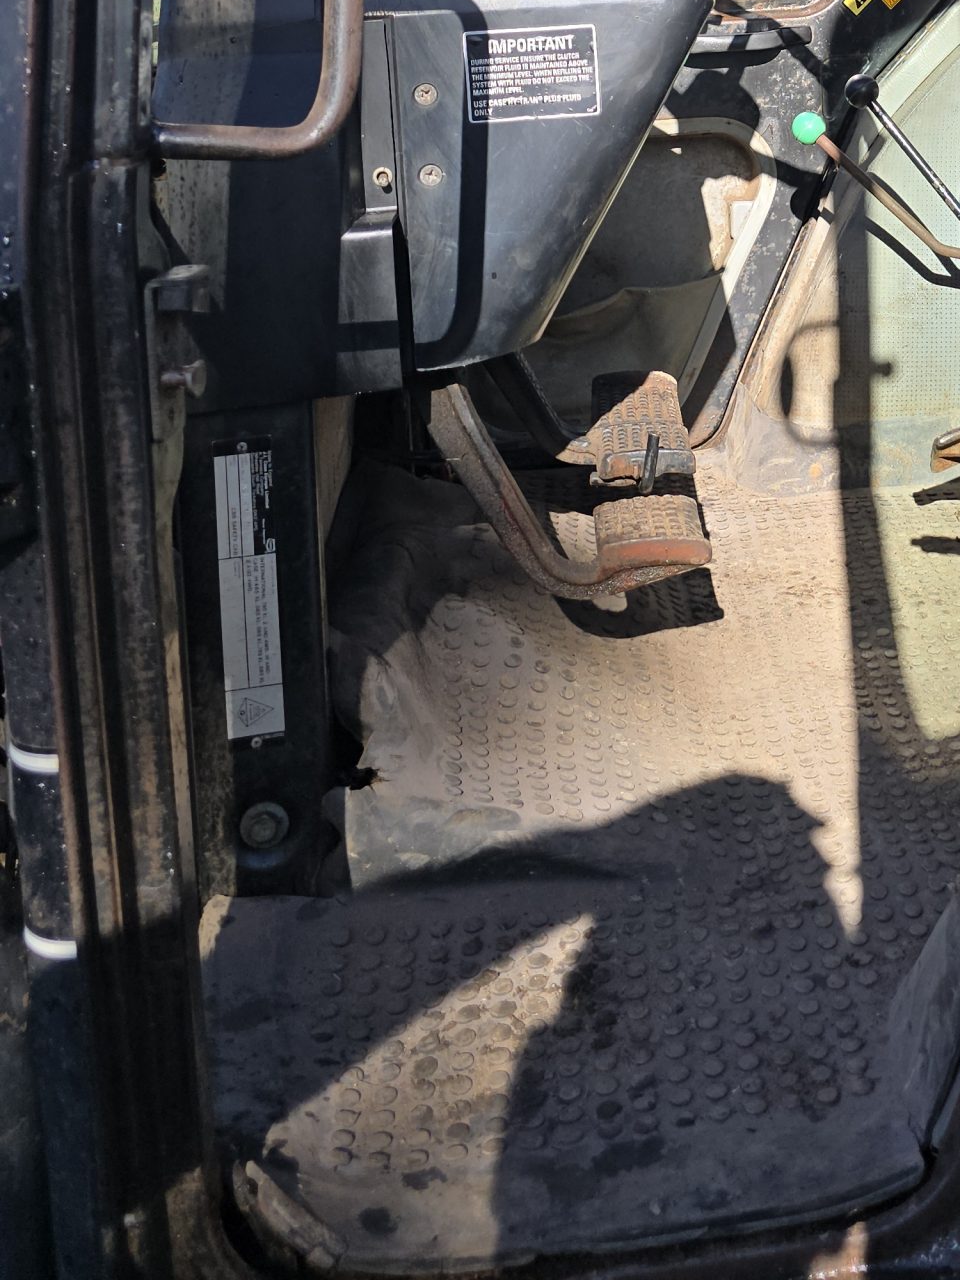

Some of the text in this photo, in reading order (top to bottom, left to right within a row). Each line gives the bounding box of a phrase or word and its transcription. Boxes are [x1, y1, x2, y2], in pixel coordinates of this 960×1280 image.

[488, 34, 574, 54] IMPORTANT
[495, 56, 519, 64] SERVICE
[520, 55, 543, 63] ENSURE
[471, 65, 504, 73] RESERVOIR
[553, 68, 581, 76] REFILLING
[497, 79, 514, 87] WITH
[473, 88, 504, 96] MAXIMUM
[474, 100, 487, 108] USE
[489, 98, 507, 106] CASE
[544, 95, 561, 103] PLUS
[562, 94, 581, 102] FLUID
[474, 108, 492, 116] ONLY
